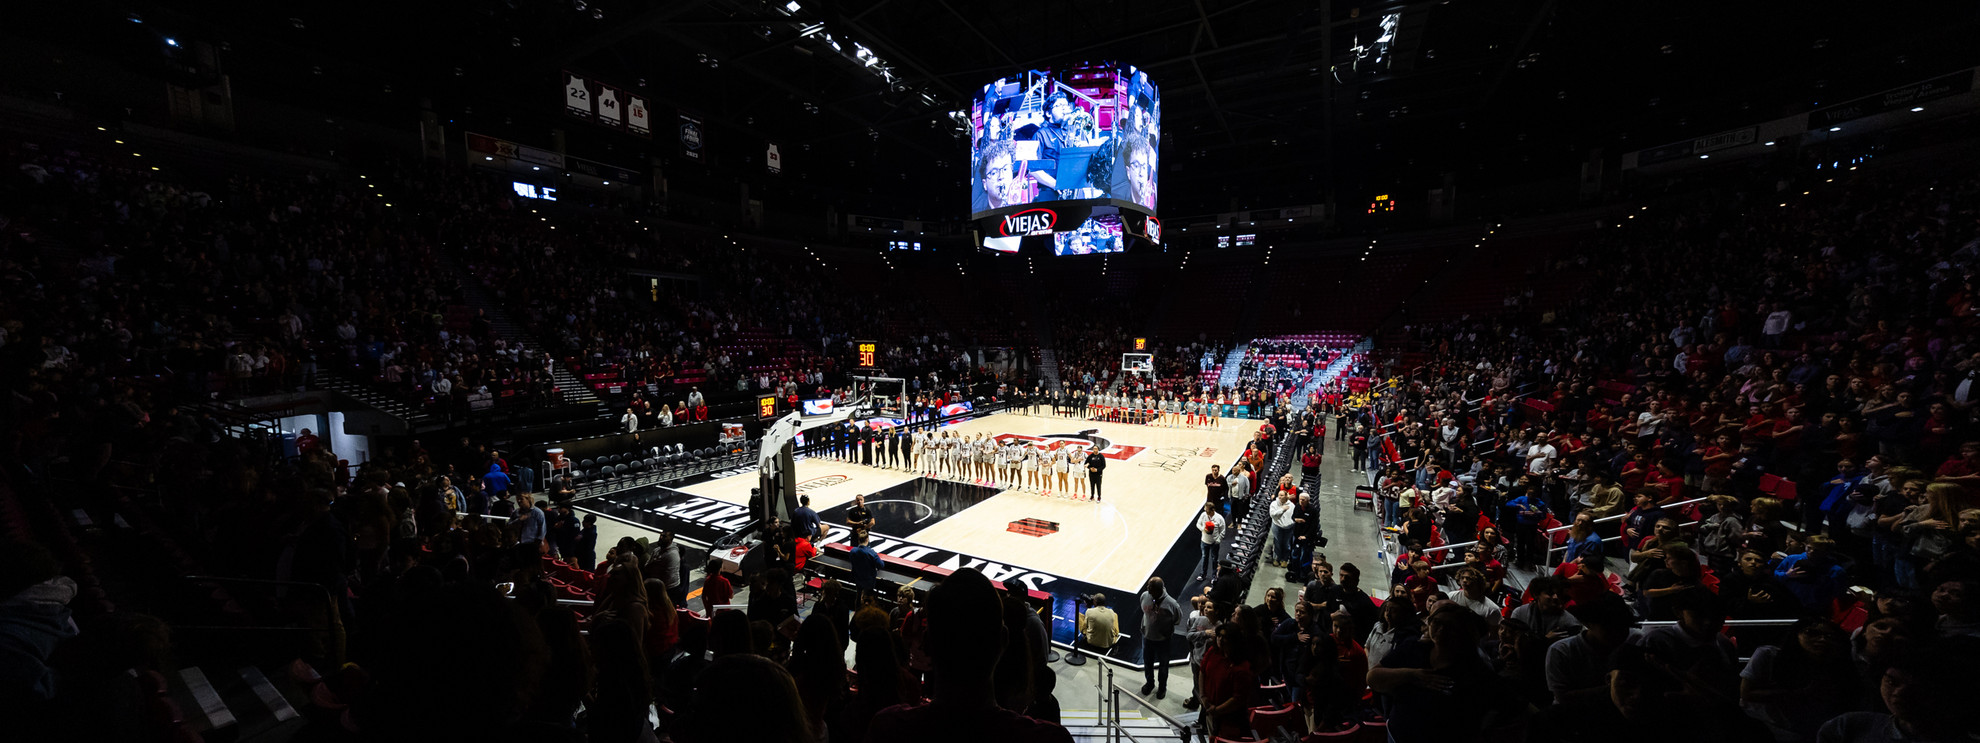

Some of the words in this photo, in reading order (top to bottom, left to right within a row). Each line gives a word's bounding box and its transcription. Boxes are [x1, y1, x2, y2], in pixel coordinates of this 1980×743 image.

[571, 87, 586, 100] 22
[603, 99, 615, 109] 44
[1005, 213, 1050, 236] VIEJAS
[859, 343, 875, 352] 10:00
[860, 352, 874, 366] 30
[761, 397, 774, 406] 10:00
[762, 406, 773, 416] 30
